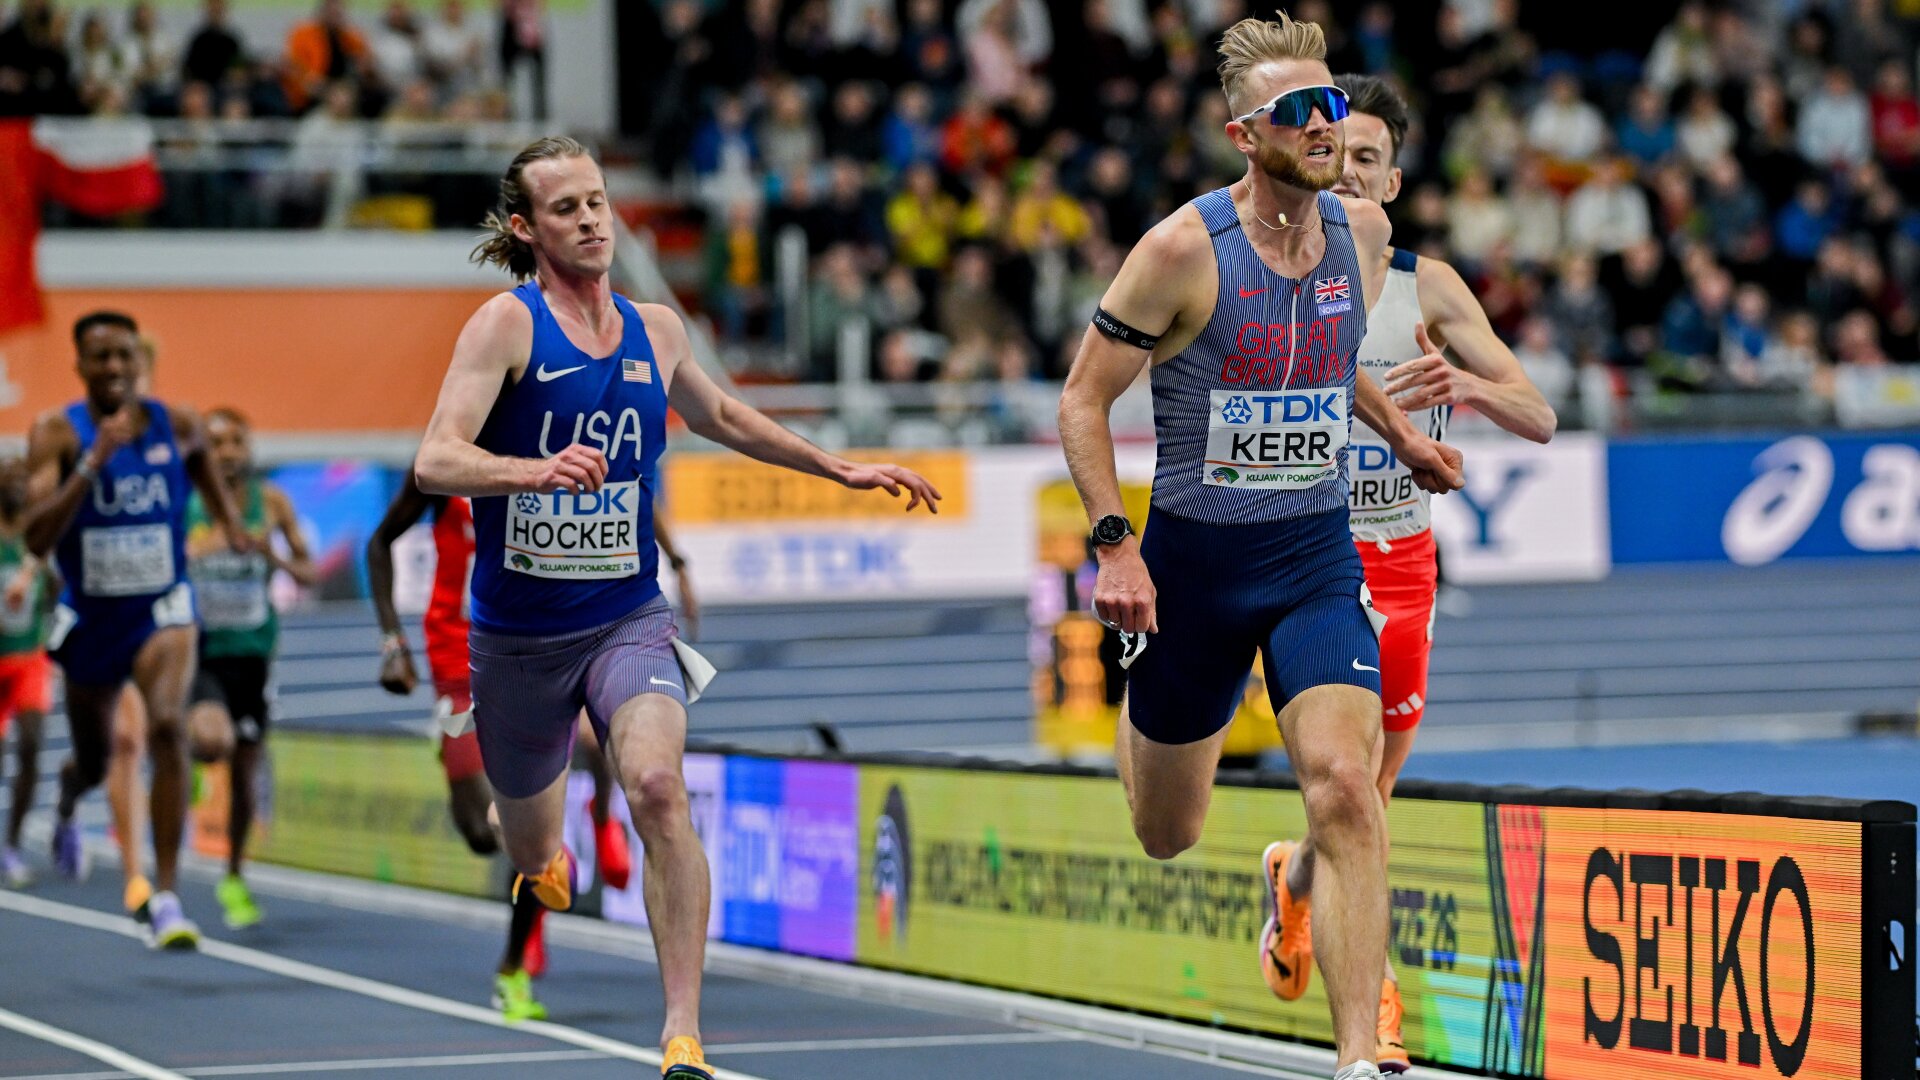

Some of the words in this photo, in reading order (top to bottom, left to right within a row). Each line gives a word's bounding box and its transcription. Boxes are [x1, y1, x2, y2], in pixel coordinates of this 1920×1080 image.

[1095, 315, 1129, 339] amazfit
[1237, 316, 1343, 355] GREAT
[1221, 351, 1349, 386] BRITAIN
[1252, 392, 1341, 424] TDK
[539, 407, 642, 461] USA
[1231, 431, 1331, 462] KERR
[1246, 473, 1285, 482] KUJAWY
[93, 472, 171, 517] USA
[552, 486, 630, 516] TDK
[513, 516, 631, 549] HOCKER
[539, 563, 577, 572] KUJAWY
[578, 563, 622, 573] POMORZE
[623, 562, 635, 571] 26
[1583, 846, 1816, 1078] SEIKO
